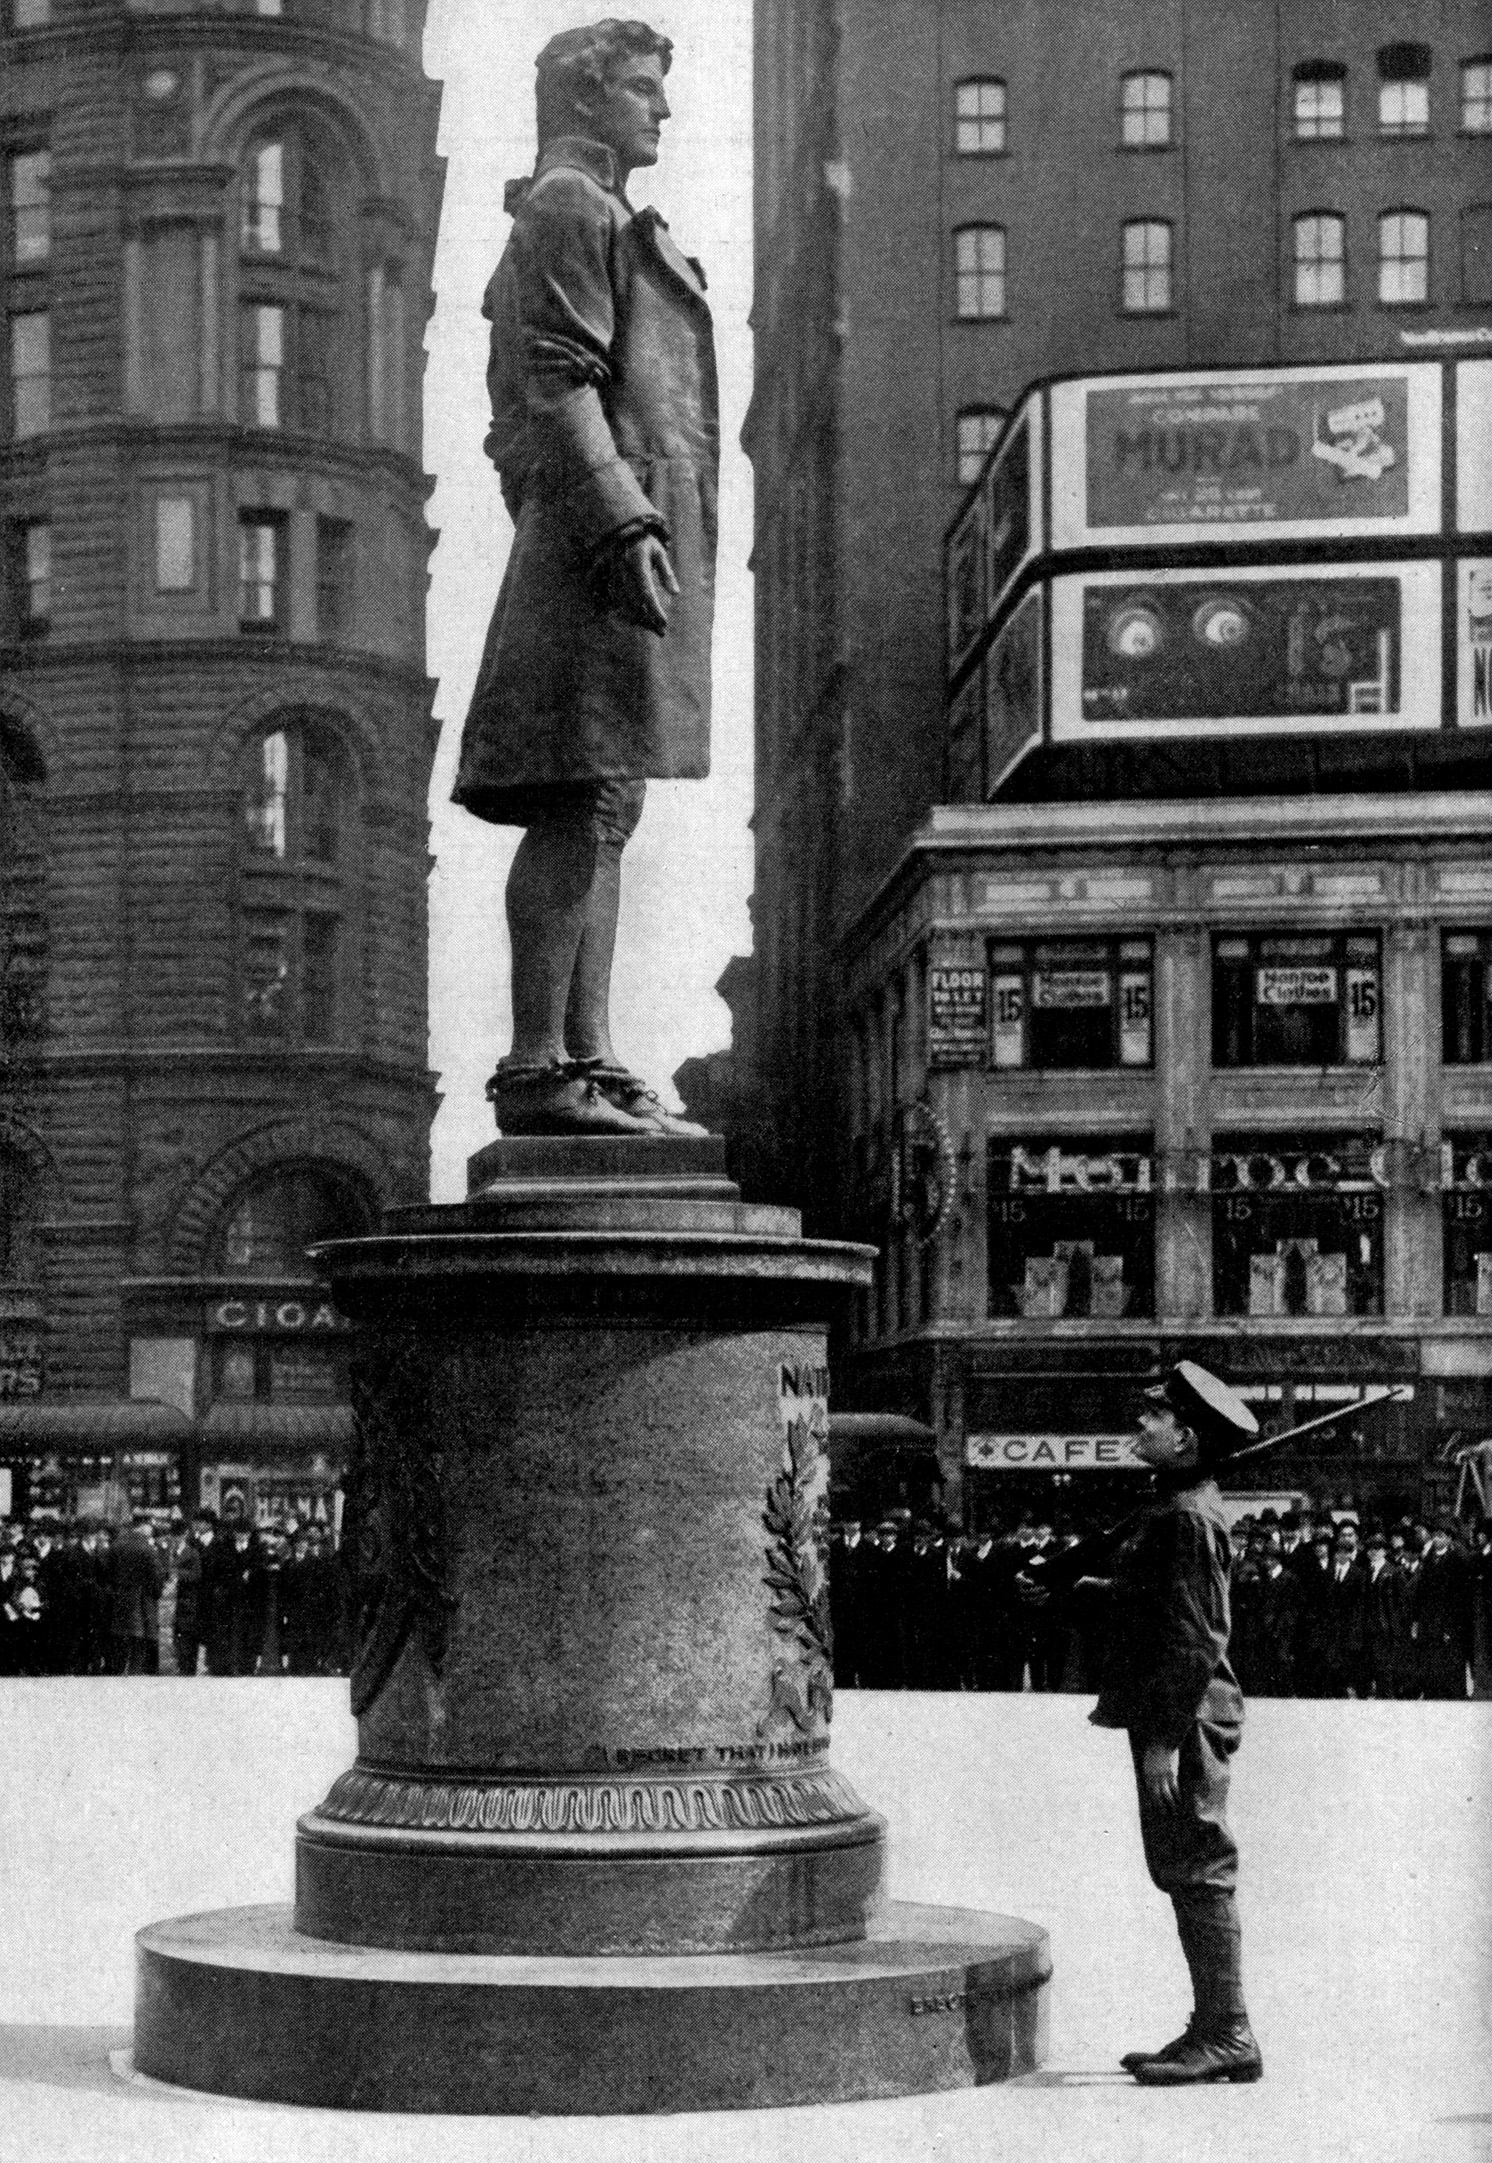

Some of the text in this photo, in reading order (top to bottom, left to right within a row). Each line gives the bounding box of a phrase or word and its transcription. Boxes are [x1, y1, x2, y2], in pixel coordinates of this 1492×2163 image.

[1114, 426, 1300, 473] MURAD
[932, 972, 984, 989] FLOOR
[999, 989, 1022, 1022] 15
[1126, 986, 1148, 1020] 15
[1351, 982, 1377, 1017] 15
[216, 1302, 350, 1328] CIGA
[1003, 1439, 1121, 1462] CAFE
[715, 1744, 766, 1762] THAT
